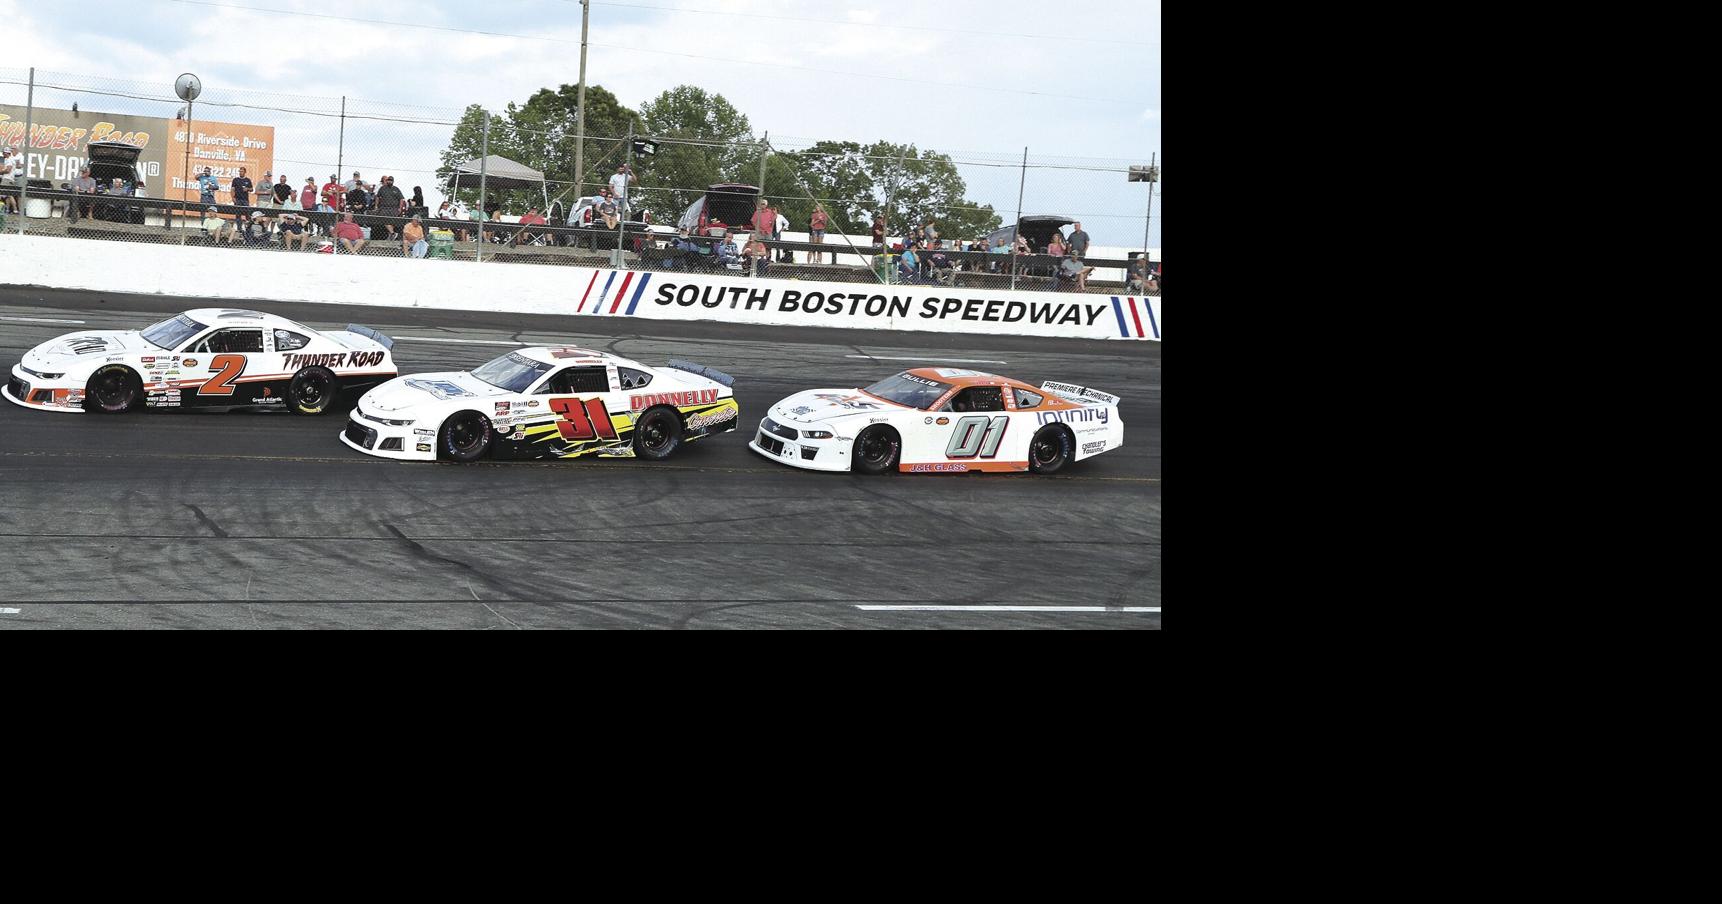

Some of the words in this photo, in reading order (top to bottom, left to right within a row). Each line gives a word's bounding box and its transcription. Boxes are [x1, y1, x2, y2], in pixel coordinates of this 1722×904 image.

[0, 113, 87, 150] HUNDER
[197, 132, 240, 147] Riverside
[243, 136, 267, 150] Drive
[194, 146, 232, 162] Danville,
[235, 149, 246, 162] VA
[654, 283, 772, 311] SOUTH
[778, 290, 912, 318] BOSTON
[919, 296, 1108, 326] SPEEDWAY
[282, 353, 346, 371] THUNDER
[346, 350, 386, 368] ROAD
[197, 353, 248, 396] 2
[1043, 381, 1078, 394] PREMIERE
[629, 388, 719, 412] DONNELLY
[548, 397, 621, 443] 31
[945, 416, 1010, 460] 01
[911, 463, 932, 472] J&H
[934, 463, 967, 472] GLASS
